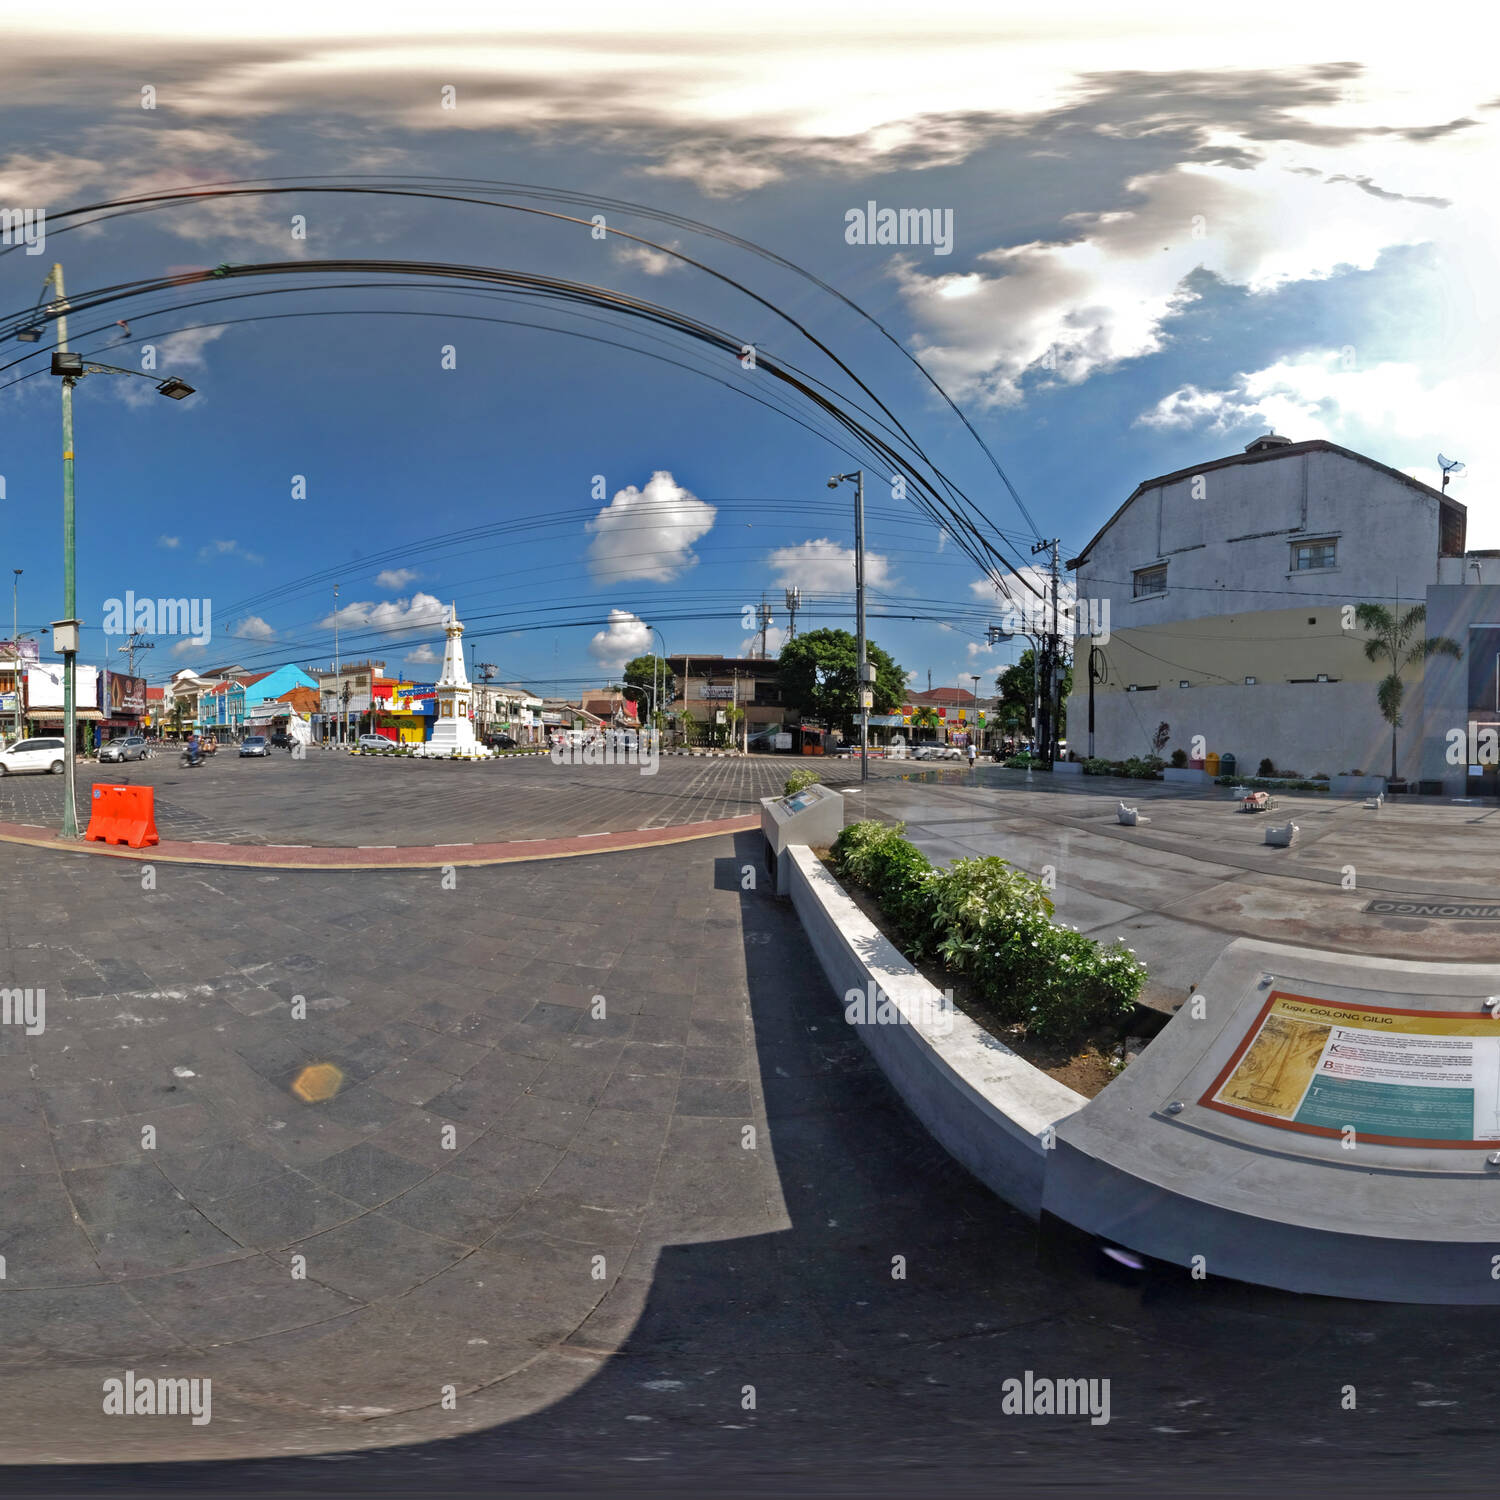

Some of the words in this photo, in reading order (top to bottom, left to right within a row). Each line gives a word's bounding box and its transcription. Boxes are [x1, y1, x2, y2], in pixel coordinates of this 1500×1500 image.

[1281, 1003, 1306, 1013] Tugu
[1310, 1008, 1360, 1021] GOLONG
[1362, 1016, 1394, 1025] GILIG
